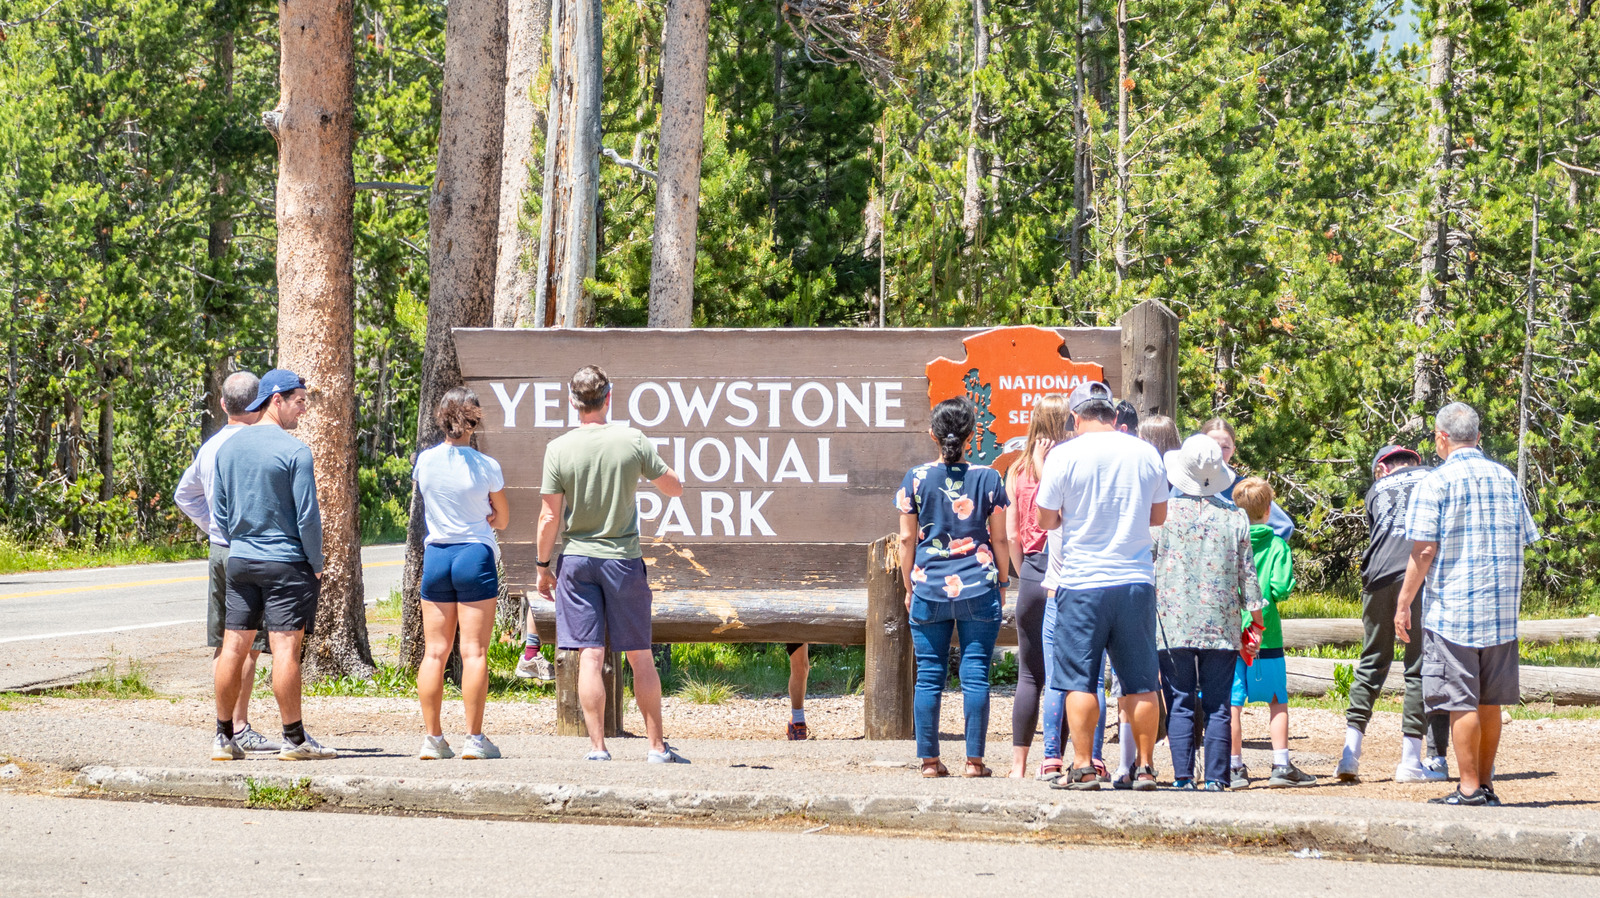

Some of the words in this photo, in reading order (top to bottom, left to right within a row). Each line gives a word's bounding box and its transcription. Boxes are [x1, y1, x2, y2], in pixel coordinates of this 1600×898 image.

[1021, 391, 1069, 407] PA
[637, 436, 848, 483] IONAL
[635, 490, 777, 536] PARK
